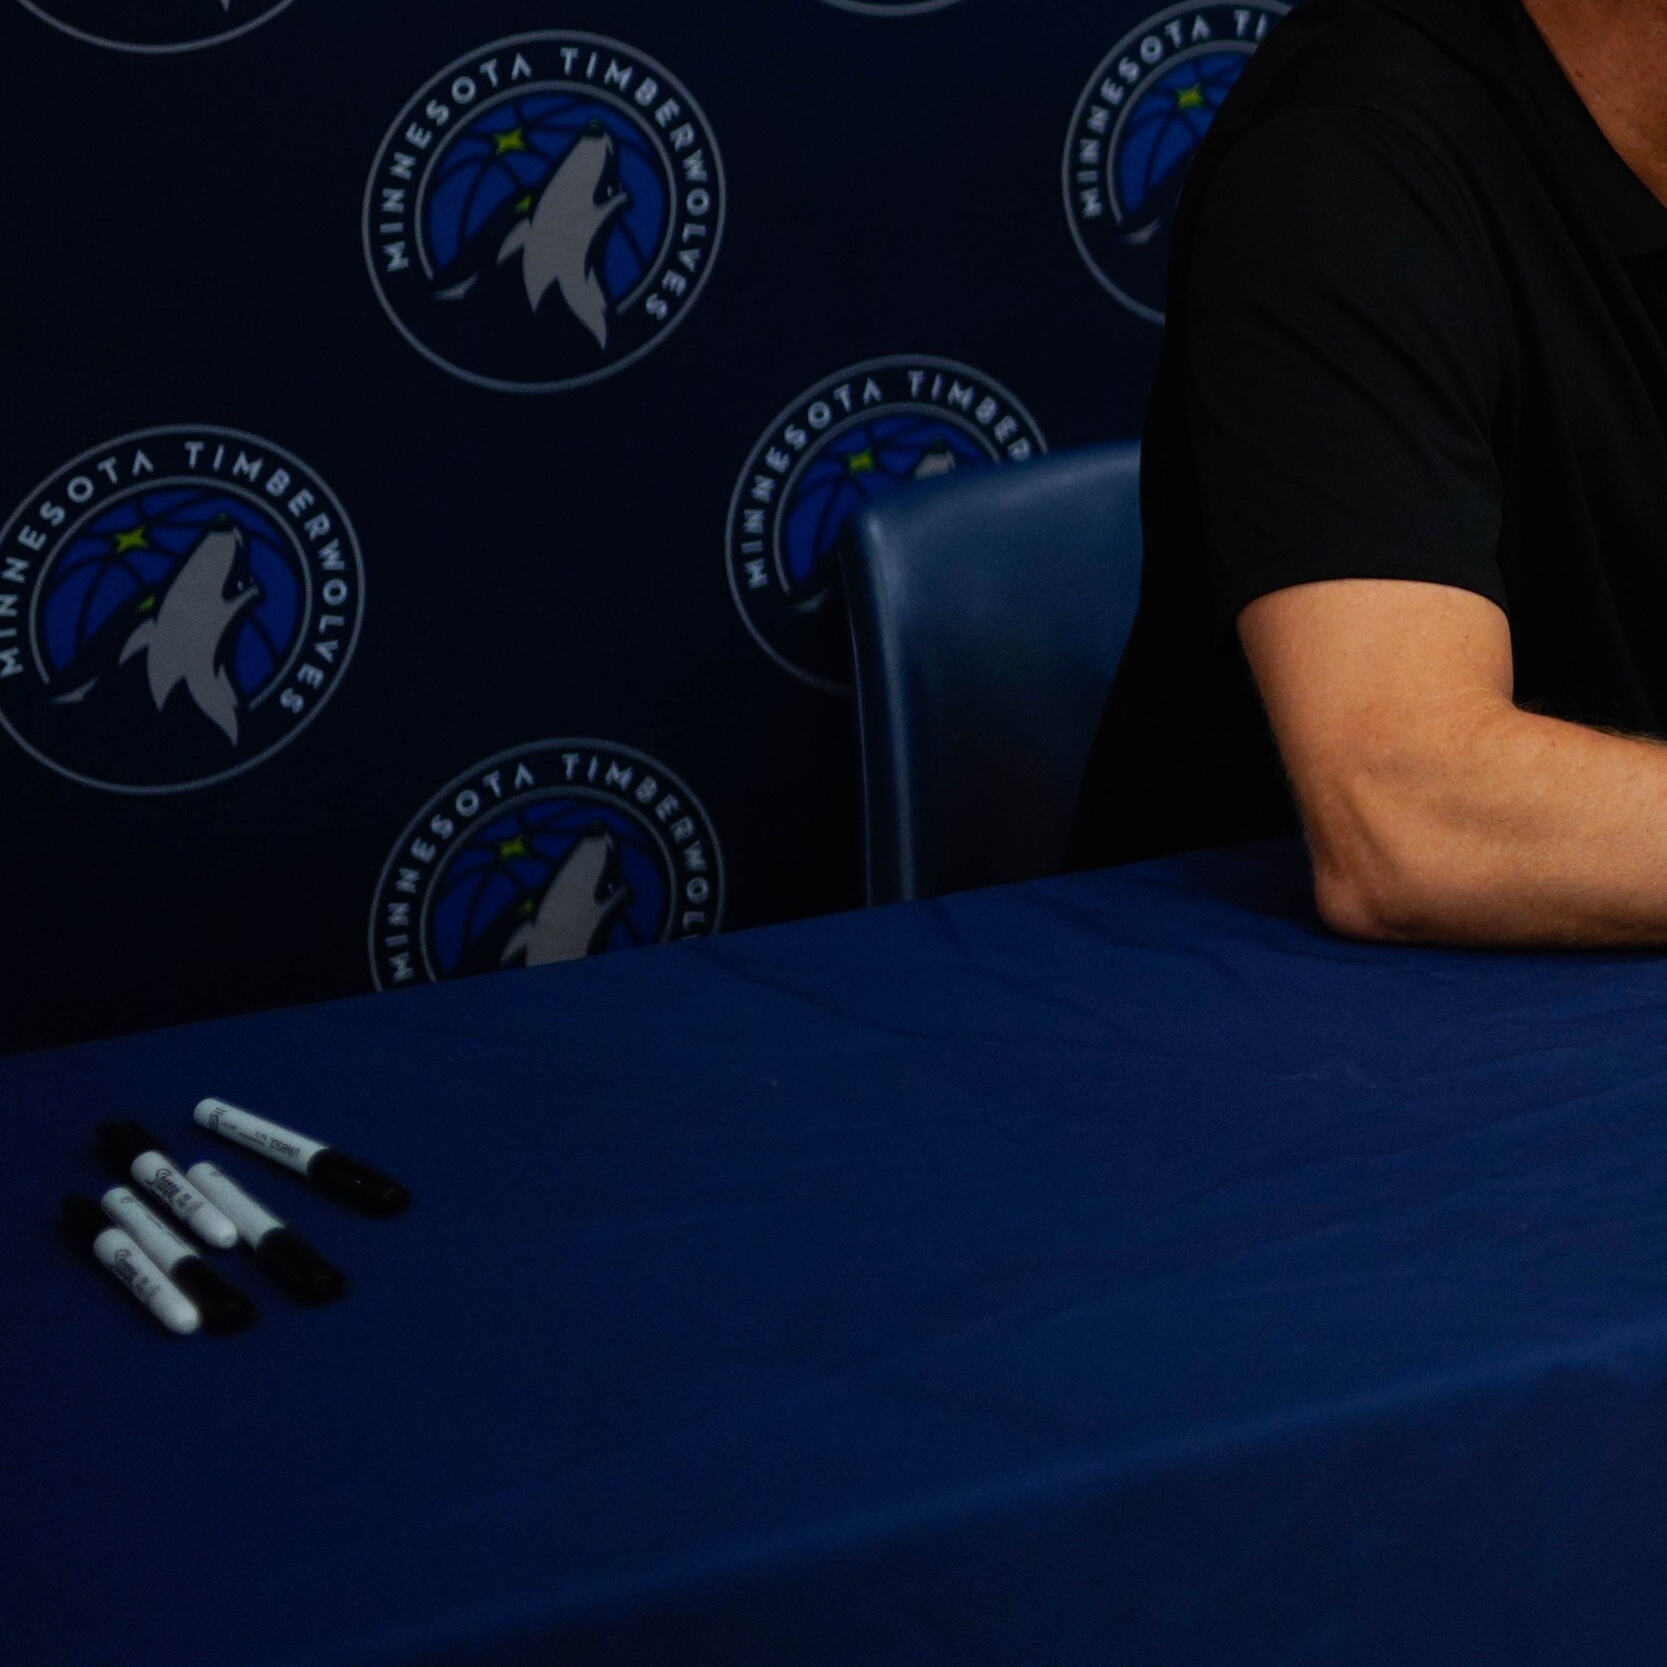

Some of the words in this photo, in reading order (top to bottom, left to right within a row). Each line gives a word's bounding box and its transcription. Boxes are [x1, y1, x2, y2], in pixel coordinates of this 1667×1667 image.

[378, 53, 532, 271] MINNESOTA
[559, 46, 710, 319] TIMBERWOLVES
[1076, 15, 1210, 216] MINNESOTA
[183, 440, 348, 713] TIMBERWOLVES
[740, 378, 882, 587] MINNESOTA
[907, 370, 1031, 464] TIMBER
[384, 762, 534, 981] MINNESOTA
[561, 752, 709, 929] TIMBERWOL
